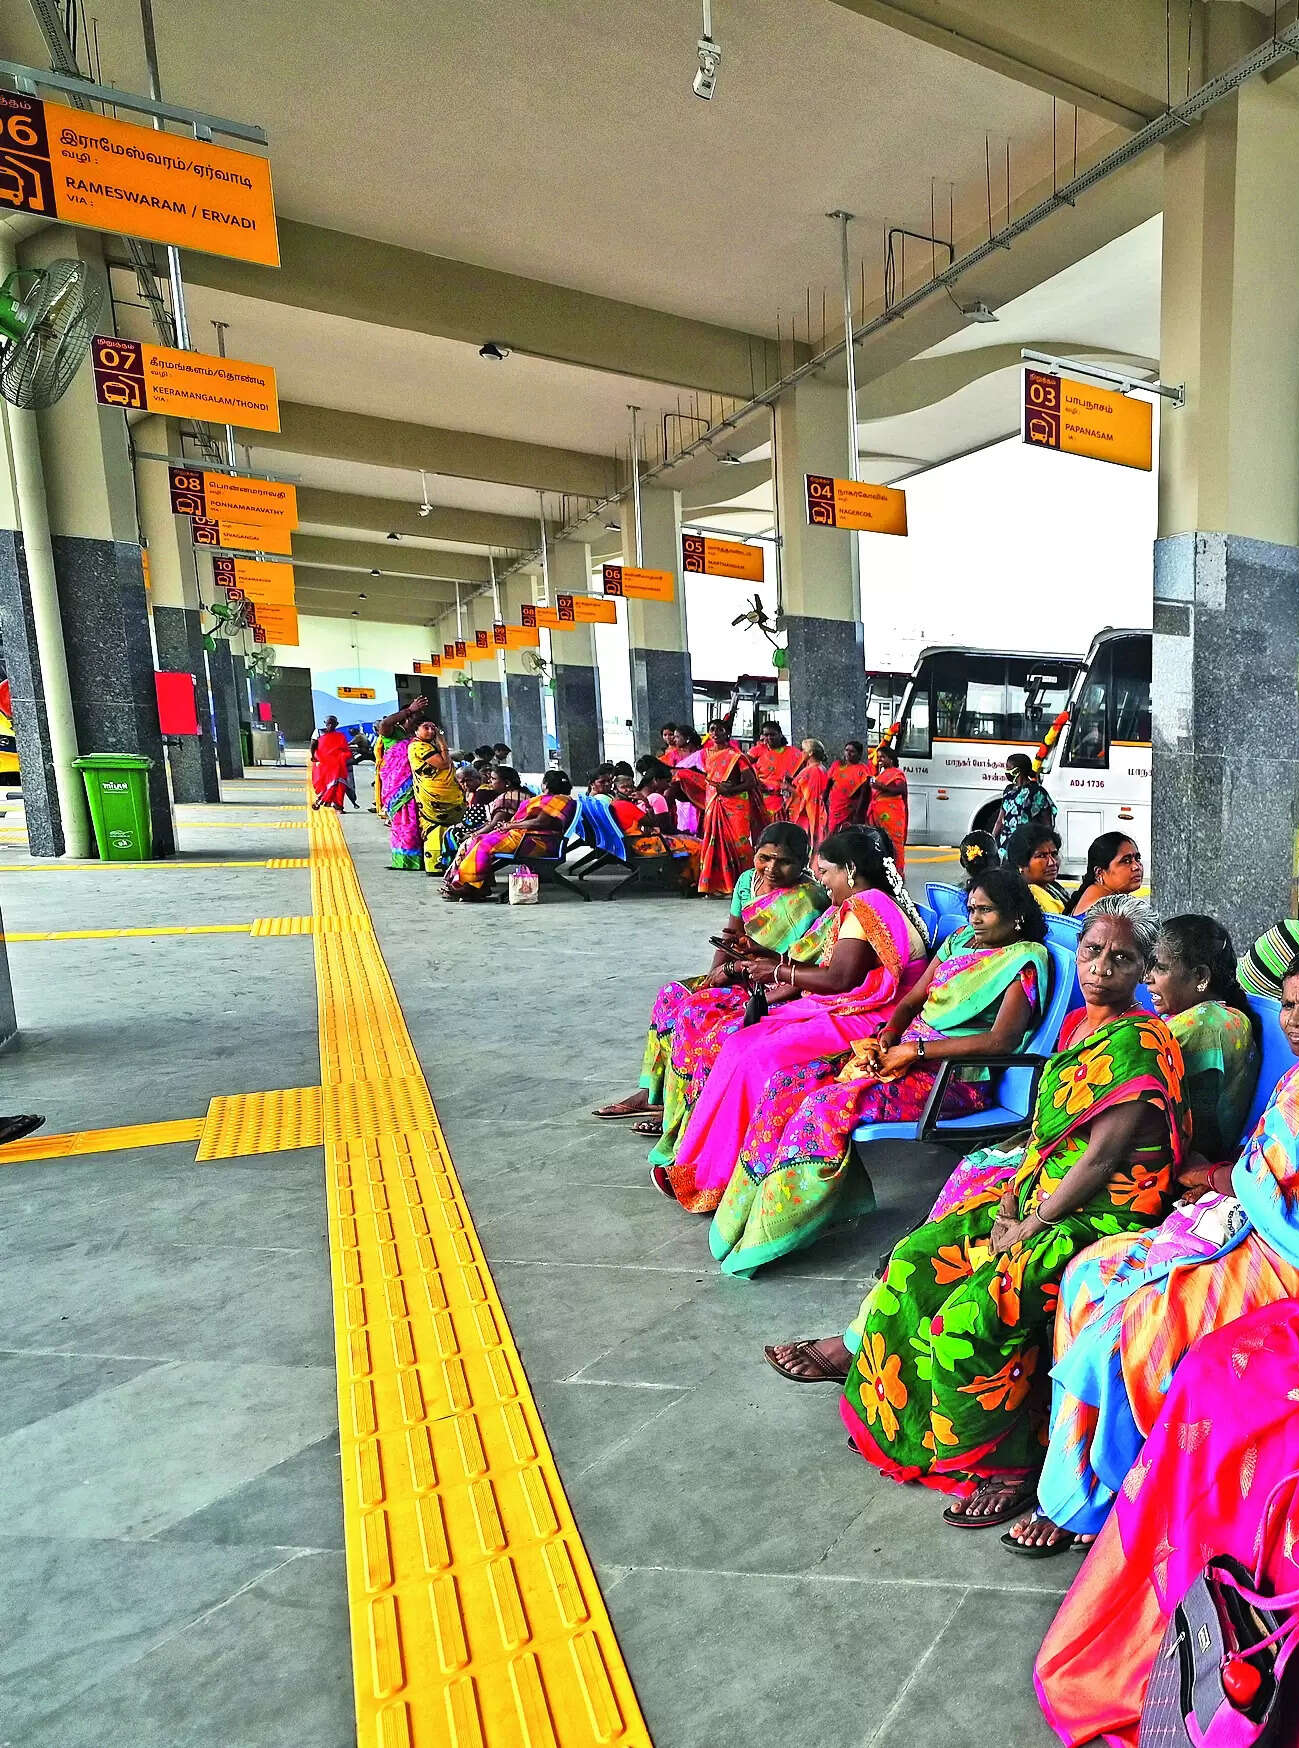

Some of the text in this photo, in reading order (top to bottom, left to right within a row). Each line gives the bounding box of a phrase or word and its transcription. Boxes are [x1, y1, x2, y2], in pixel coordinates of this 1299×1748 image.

[60, 128, 253, 190] இராமேஸ்வரம்/ஏர்வாடி
[65, 176, 187, 215] RAMESWARAM
[202, 208, 256, 230] ERVADI
[100, 348, 136, 370] 07
[152, 385, 269, 411] KEERAMANGALAM/THONDI
[1030, 384, 1056, 407] 03
[1065, 394, 1113, 414] பாபநாசம்
[1065, 423, 1114, 441] PAPANASAM
[174, 475, 201, 490] 08
[810, 484, 833, 498] 04
[210, 500, 284, 517] PONNAMARAVATHY
[685, 541, 702, 553] 05
[217, 562, 231, 571] 10
[606, 569, 621, 579] 06
[560, 600, 571, 608] 07
